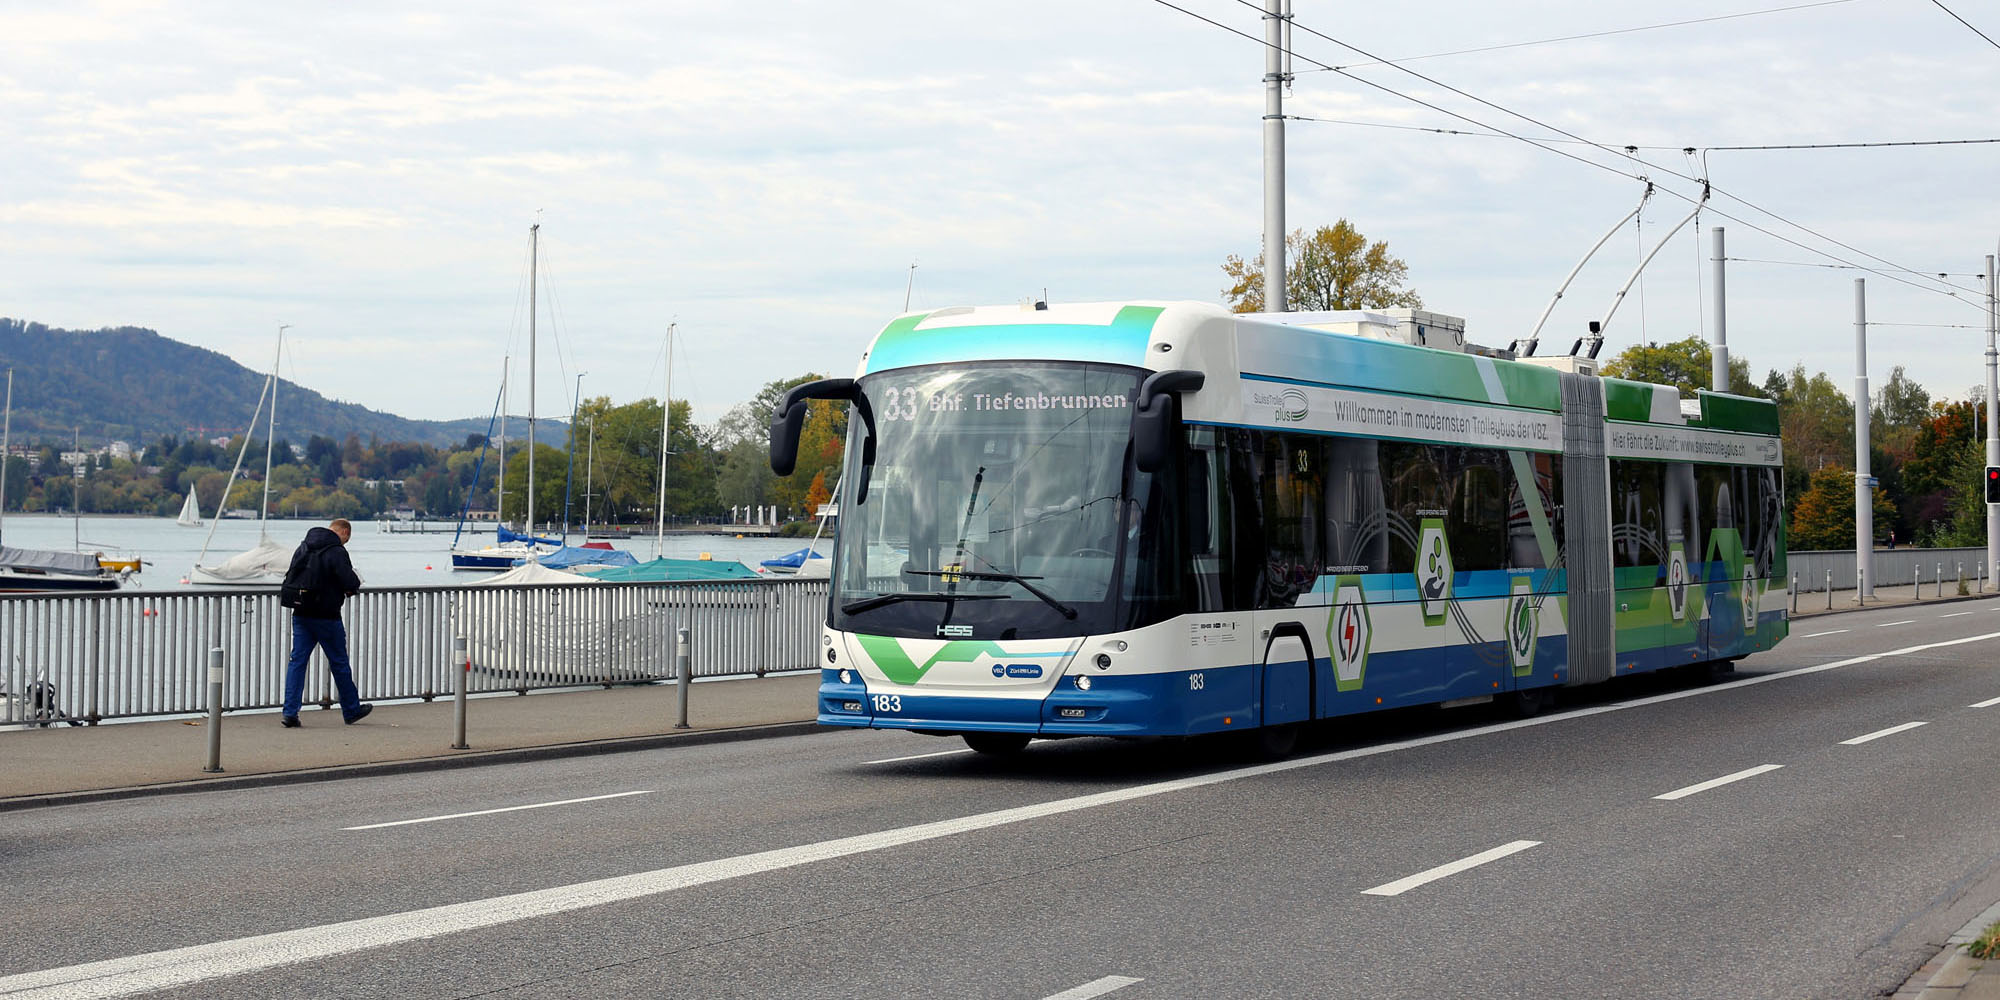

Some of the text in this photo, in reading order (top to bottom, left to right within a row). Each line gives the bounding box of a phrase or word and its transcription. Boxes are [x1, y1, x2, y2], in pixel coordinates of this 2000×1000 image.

[884, 386, 1127, 421] 33 Bhf. Tiefenbrunnen
[1275, 408, 1290, 423] plus
[1334, 400, 1549, 441] Willkommen im modernsten Trolleybus der VBZ.
[1612, 432, 1626, 449] Hier
[1626, 432, 1643, 450] fährt
[1643, 433, 1654, 450] die
[1297, 449, 1308, 472] 33
[936, 625, 973, 636] HESS
[1189, 673, 1204, 690] 183
[872, 695, 901, 712] 183
